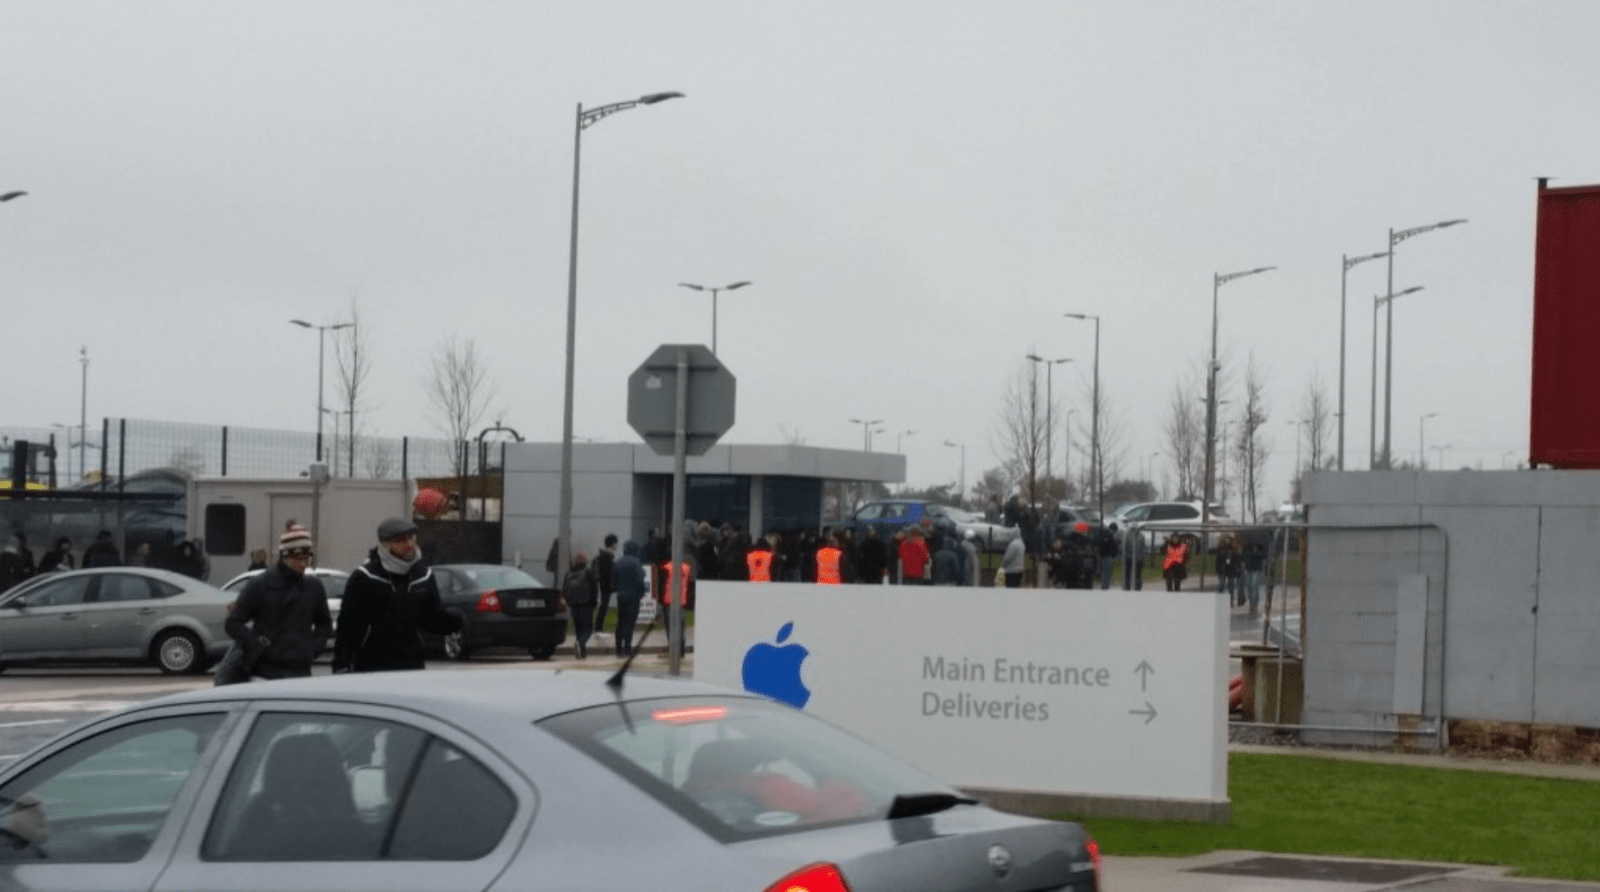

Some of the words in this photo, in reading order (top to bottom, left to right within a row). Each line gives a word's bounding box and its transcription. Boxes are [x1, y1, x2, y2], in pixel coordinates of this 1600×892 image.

[922, 656, 985, 683] Main
[994, 657, 1110, 687] Entrance
[922, 691, 1050, 721] Deliveries
